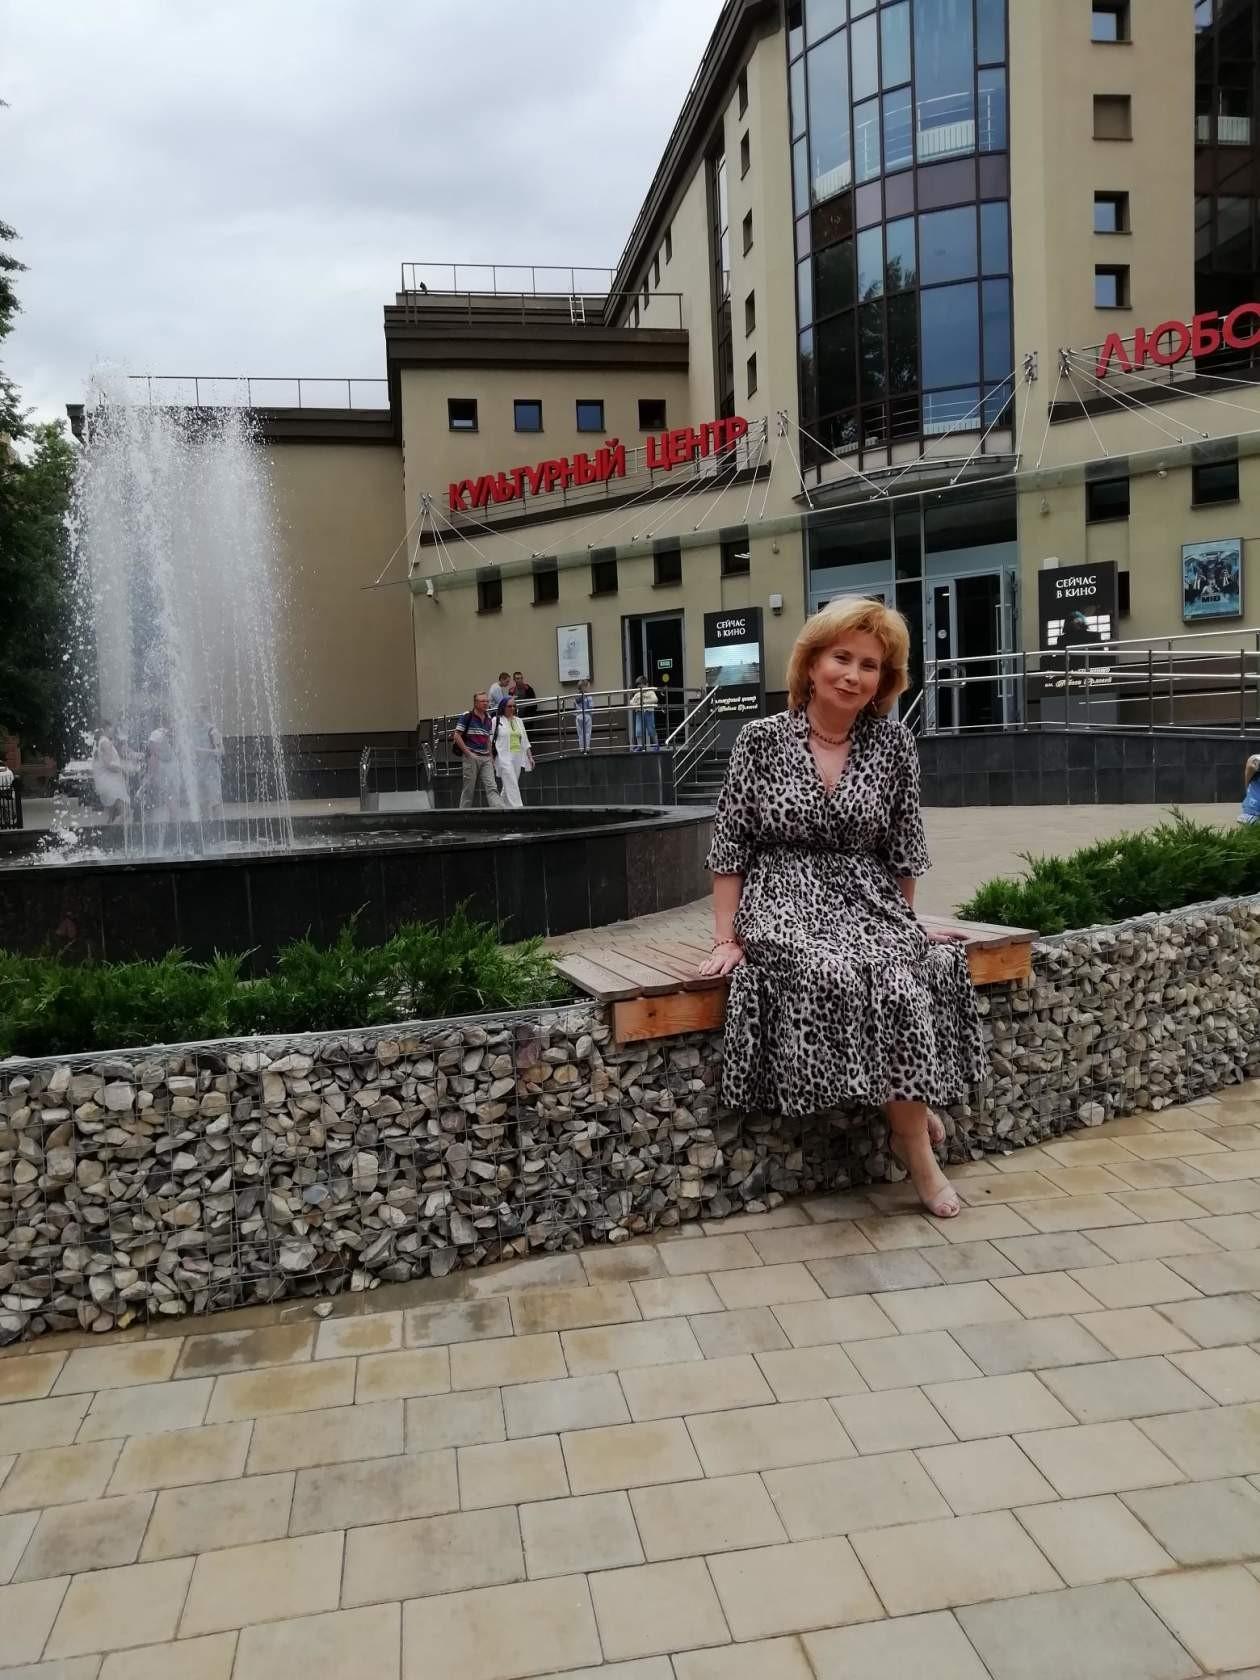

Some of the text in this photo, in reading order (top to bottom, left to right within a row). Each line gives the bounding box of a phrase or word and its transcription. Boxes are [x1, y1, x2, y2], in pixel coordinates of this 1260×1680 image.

[1095, 302, 1260, 379] ЛЮБО
[448, 416, 748, 511] КУЛЬТУРНЫЙ ЦЕНТР
[1056, 575, 1096, 588] СЕЙЧАС
[1056, 586, 1097, 599] В КИНО
[716, 618, 746, 630] СЕЙЧАС
[717, 627, 746, 639] В КИНО
